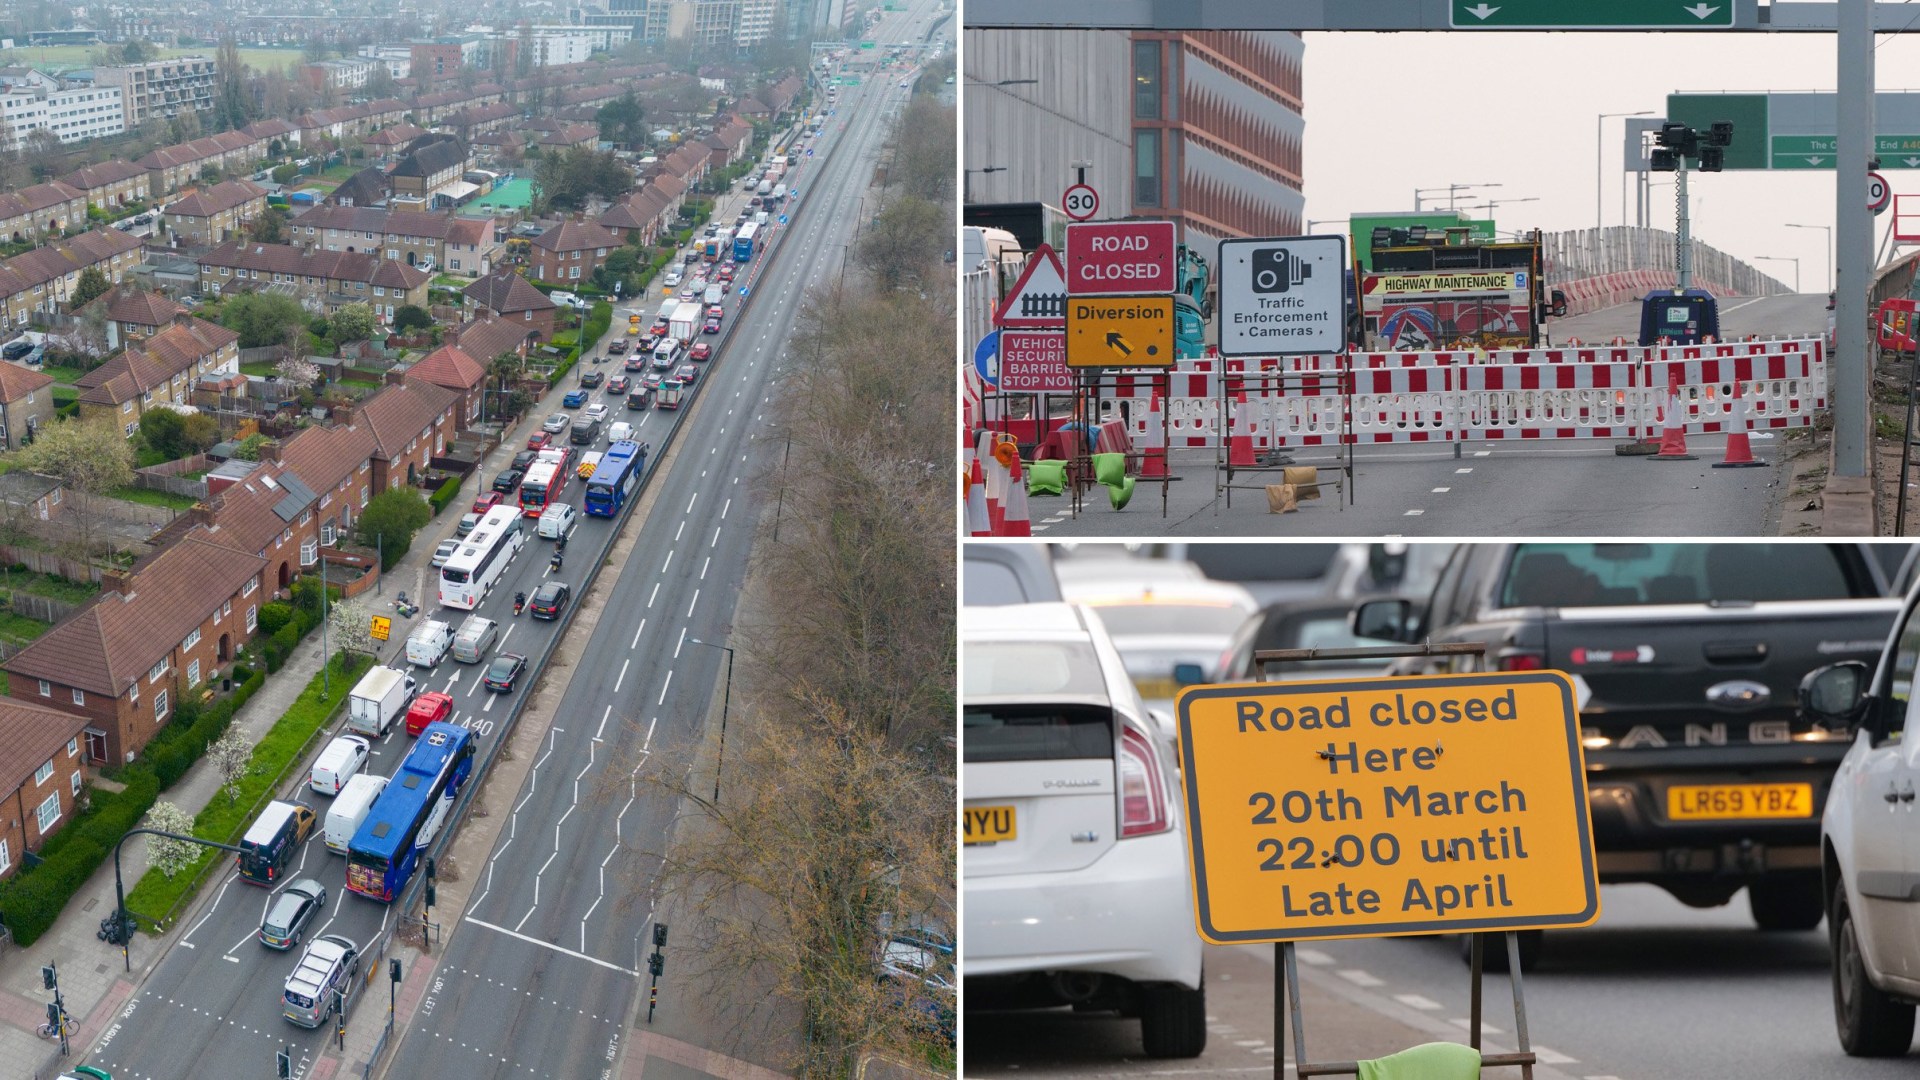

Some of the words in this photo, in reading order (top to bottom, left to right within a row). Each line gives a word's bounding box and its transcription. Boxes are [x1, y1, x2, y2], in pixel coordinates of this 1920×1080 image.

[1811, 141, 1827, 149] The
[1880, 141, 1898, 149] End
[1867, 184, 1883, 197] 0
[1068, 195, 1094, 210] 30
[1092, 236, 1149, 251] ROAD
[1081, 263, 1161, 280] CLOSED
[1385, 278, 1431, 290] HIGHWAY
[1434, 275, 1507, 289] MAINTENANCE
[1258, 297, 1305, 309] Traffic
[1077, 305, 1164, 320] Diversion
[1234, 311, 1328, 323] Enforcement
[1249, 326, 1313, 337] Cameras
[1012, 338, 1065, 349] VEHICL
[1006, 350, 1066, 361] SECURI
[1003, 376, 1040, 387] STOP
[1045, 376, 1078, 386] NOW
[1236, 696, 1351, 733] Road
[1370, 689, 1518, 727] closed
[1327, 741, 1437, 775] Here
[1248, 788, 1363, 825] 20th
[1384, 780, 1527, 818] March
[1680, 789, 1744, 813] LR69
[1750, 788, 1799, 811] YBZ
[963, 809, 1010, 836] NYU
[1257, 832, 1401, 872] 22:00
[1421, 826, 1528, 863] until
[1282, 882, 1381, 918] Late
[1401, 874, 1513, 916] April
[432, 977, 445, 994] LOOK
[120, 998, 140, 1019] LOOK
[422, 996, 437, 1017] LEFT
[100, 1023, 122, 1047] RIGHT
